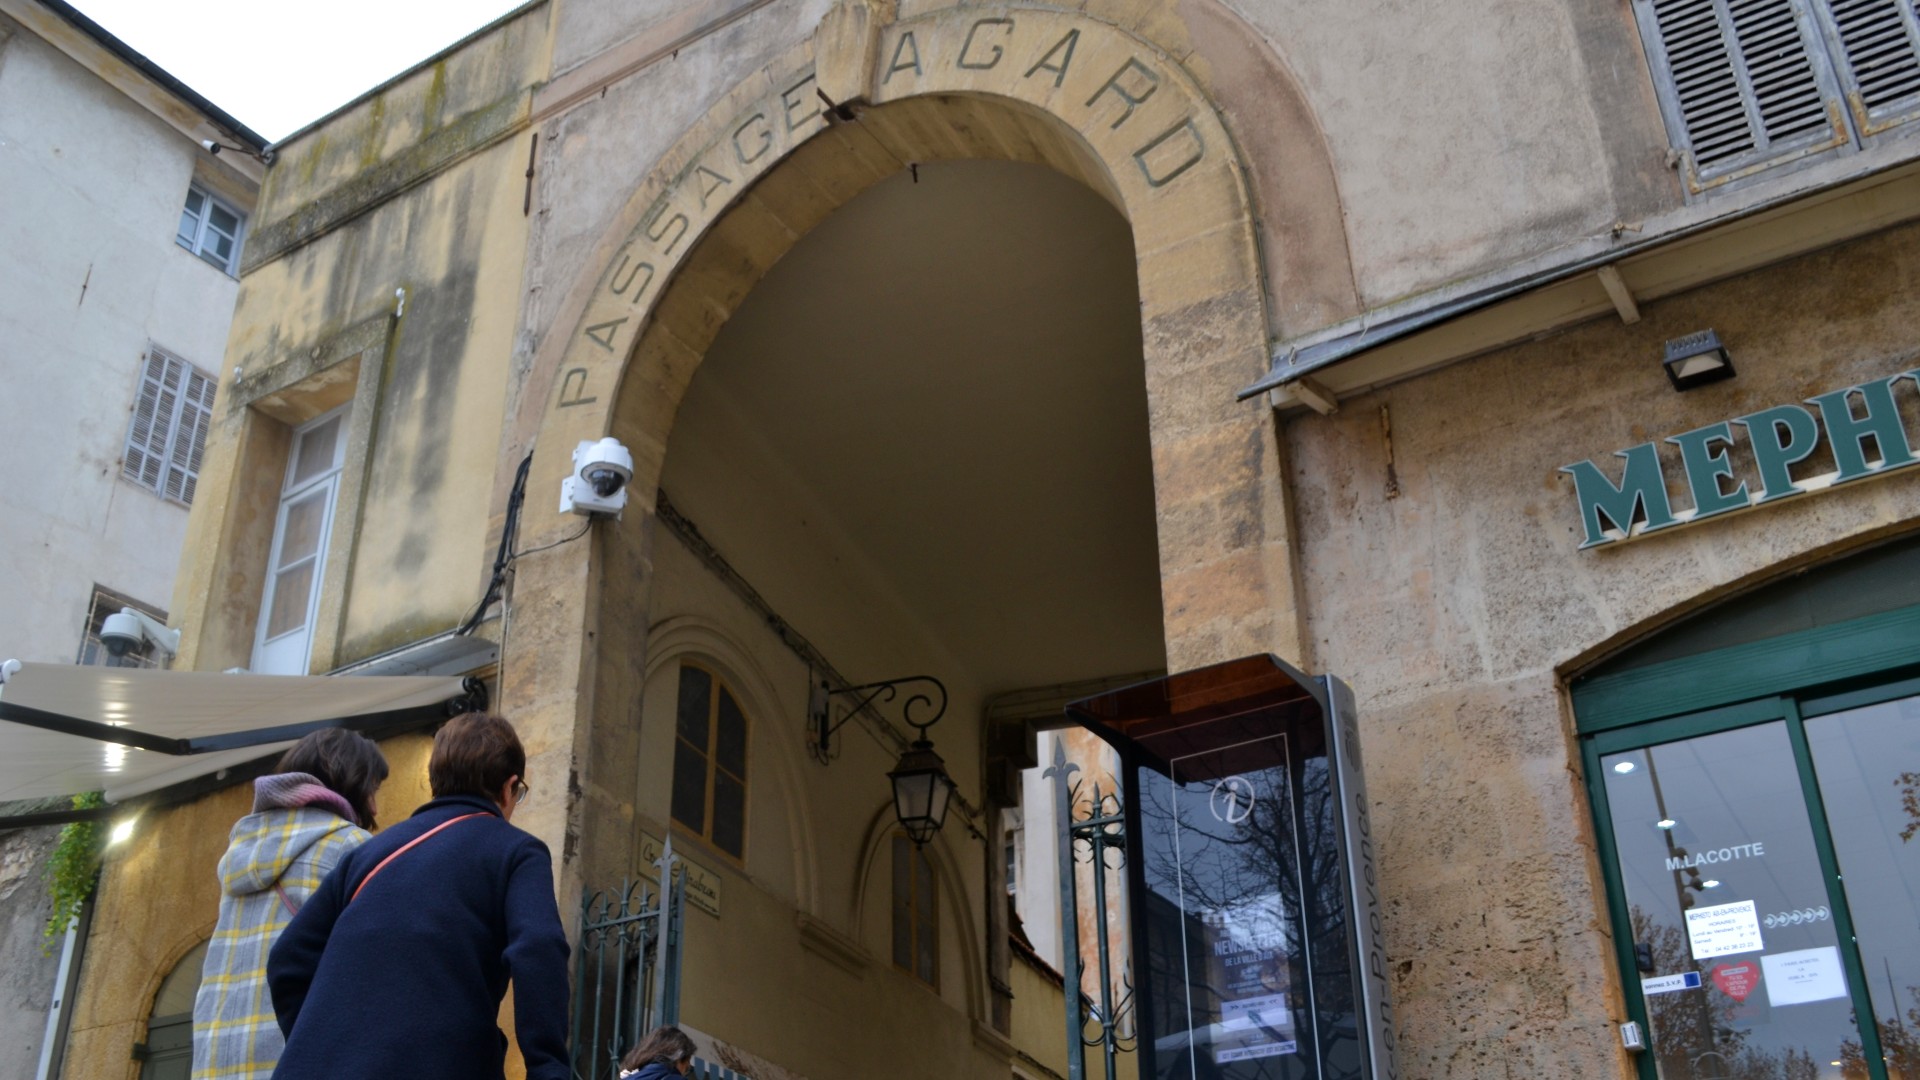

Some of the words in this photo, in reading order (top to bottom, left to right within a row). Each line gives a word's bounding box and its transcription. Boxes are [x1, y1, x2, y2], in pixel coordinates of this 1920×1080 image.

[557, 72, 821, 410] PASSAGE
[882, 16, 1206, 188] AGARD
[1558, 367, 1920, 550] MEPH
[1665, 842, 1765, 871] M.LACOTTE
